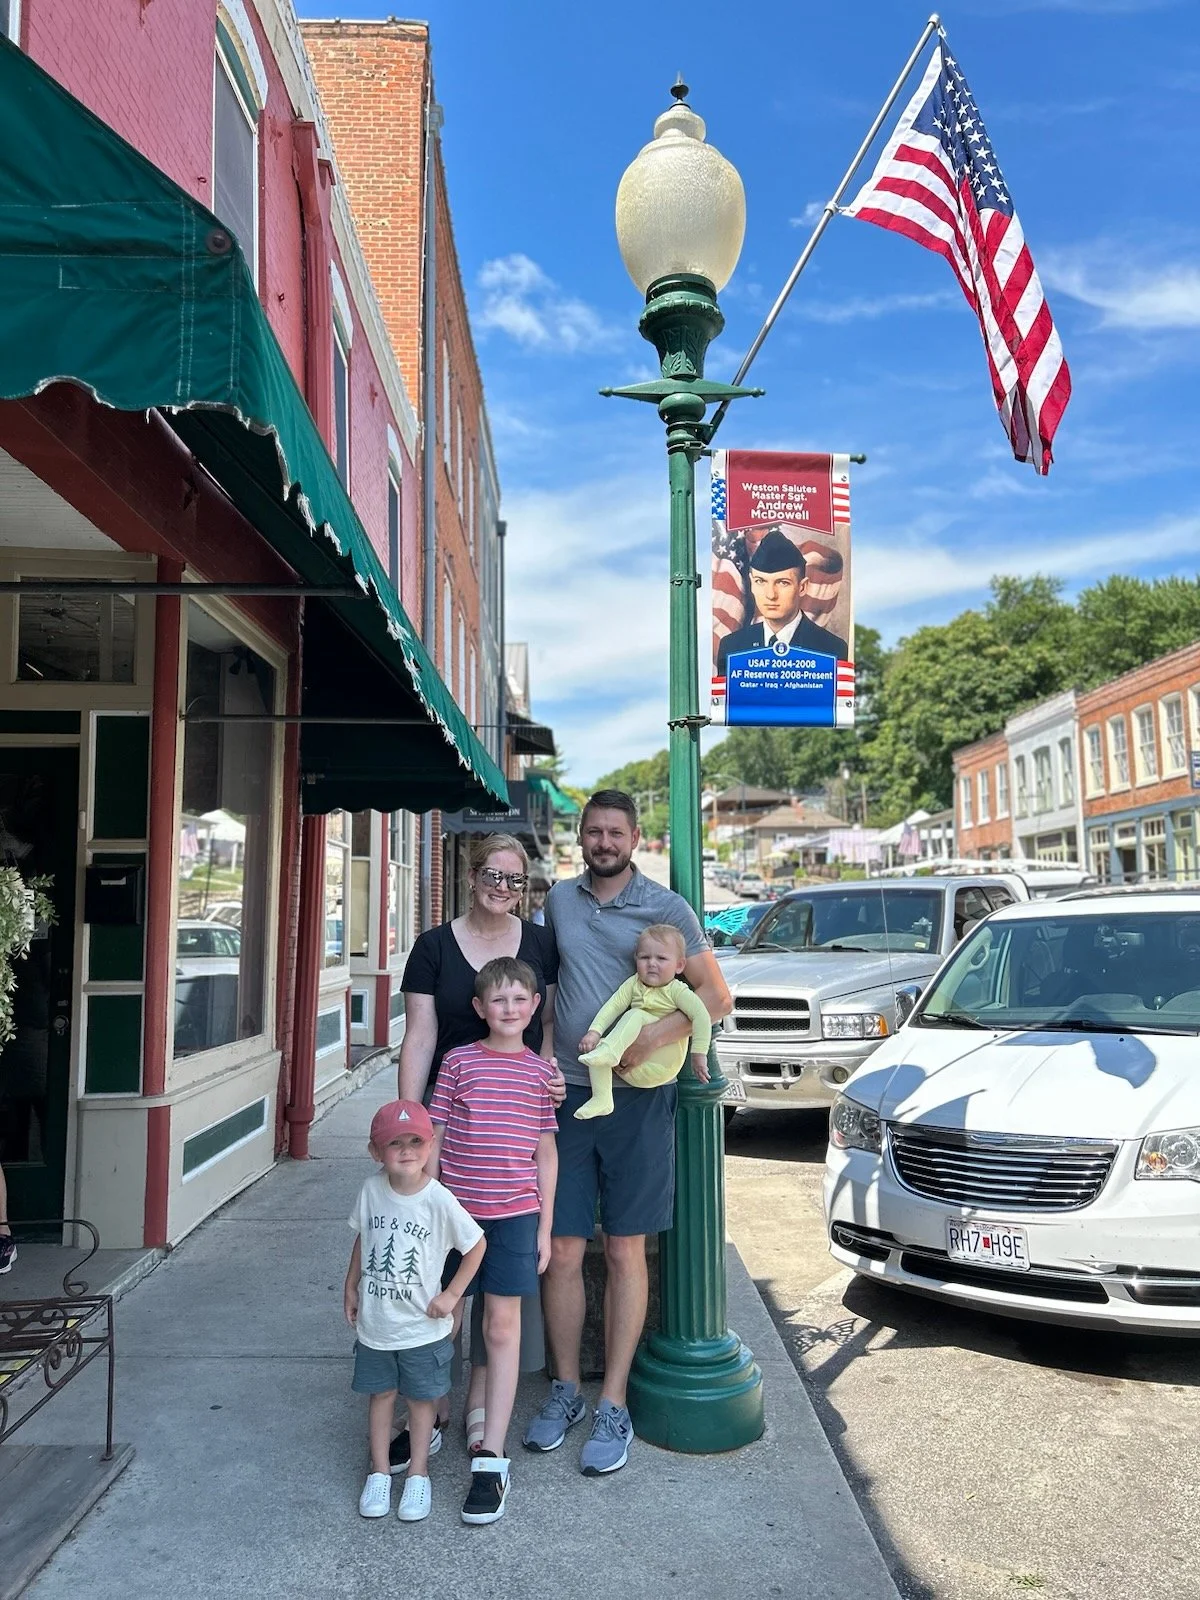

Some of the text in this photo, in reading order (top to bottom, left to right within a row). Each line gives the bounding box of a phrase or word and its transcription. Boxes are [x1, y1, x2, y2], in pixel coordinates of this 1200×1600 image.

[742, 483, 817, 493] Weston Salutes
[752, 491, 807, 502] Master Sgt.
[756, 500, 803, 510] Andrew
[751, 509, 809, 520] McDowell
[748, 659, 816, 668] USAF 2004-2008
[731, 670, 833, 680] AF Reserves 2008-Present
[390, 1217, 399, 1230] &
[950, 1228, 1024, 1259] RH7 H9E
